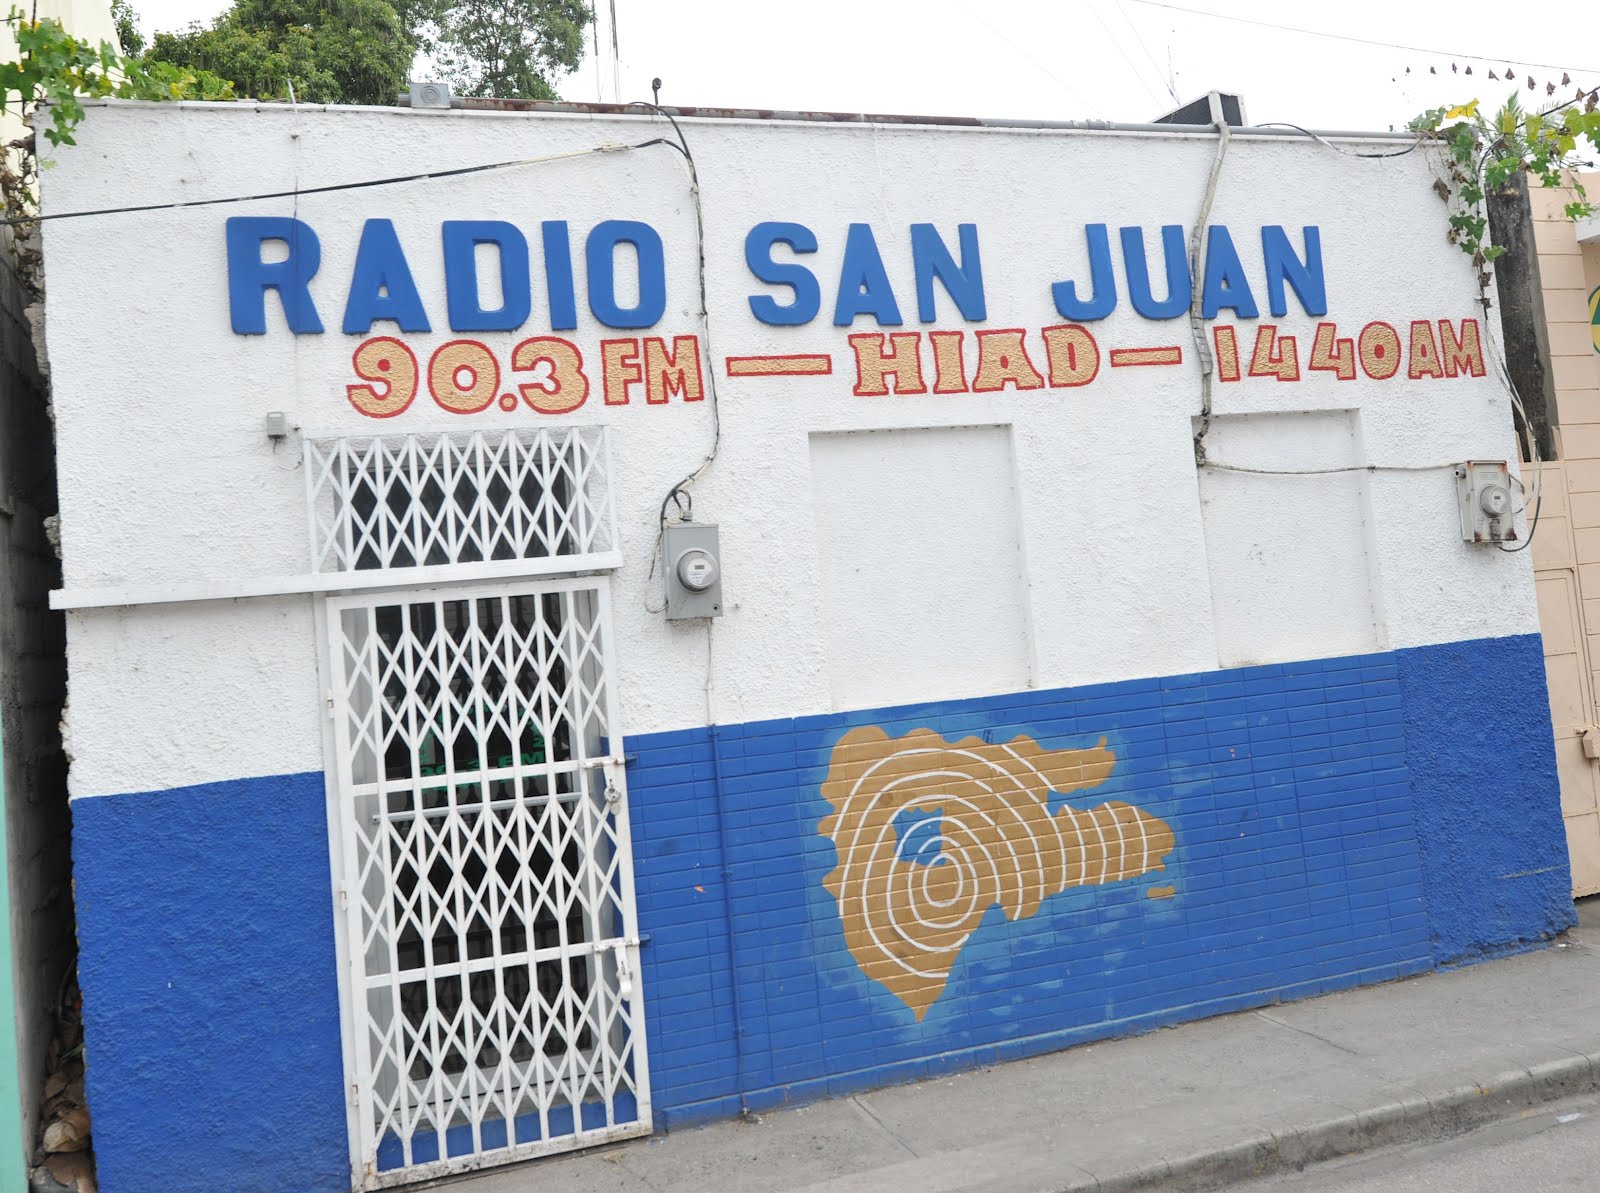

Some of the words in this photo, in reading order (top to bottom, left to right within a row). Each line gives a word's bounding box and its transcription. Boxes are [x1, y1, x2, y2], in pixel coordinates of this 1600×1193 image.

[226, 217, 666, 334] RADIO
[745, 222, 986, 326] SAN
[1052, 225, 1328, 321] JUAN
[847, 323, 1101, 397] HIAD
